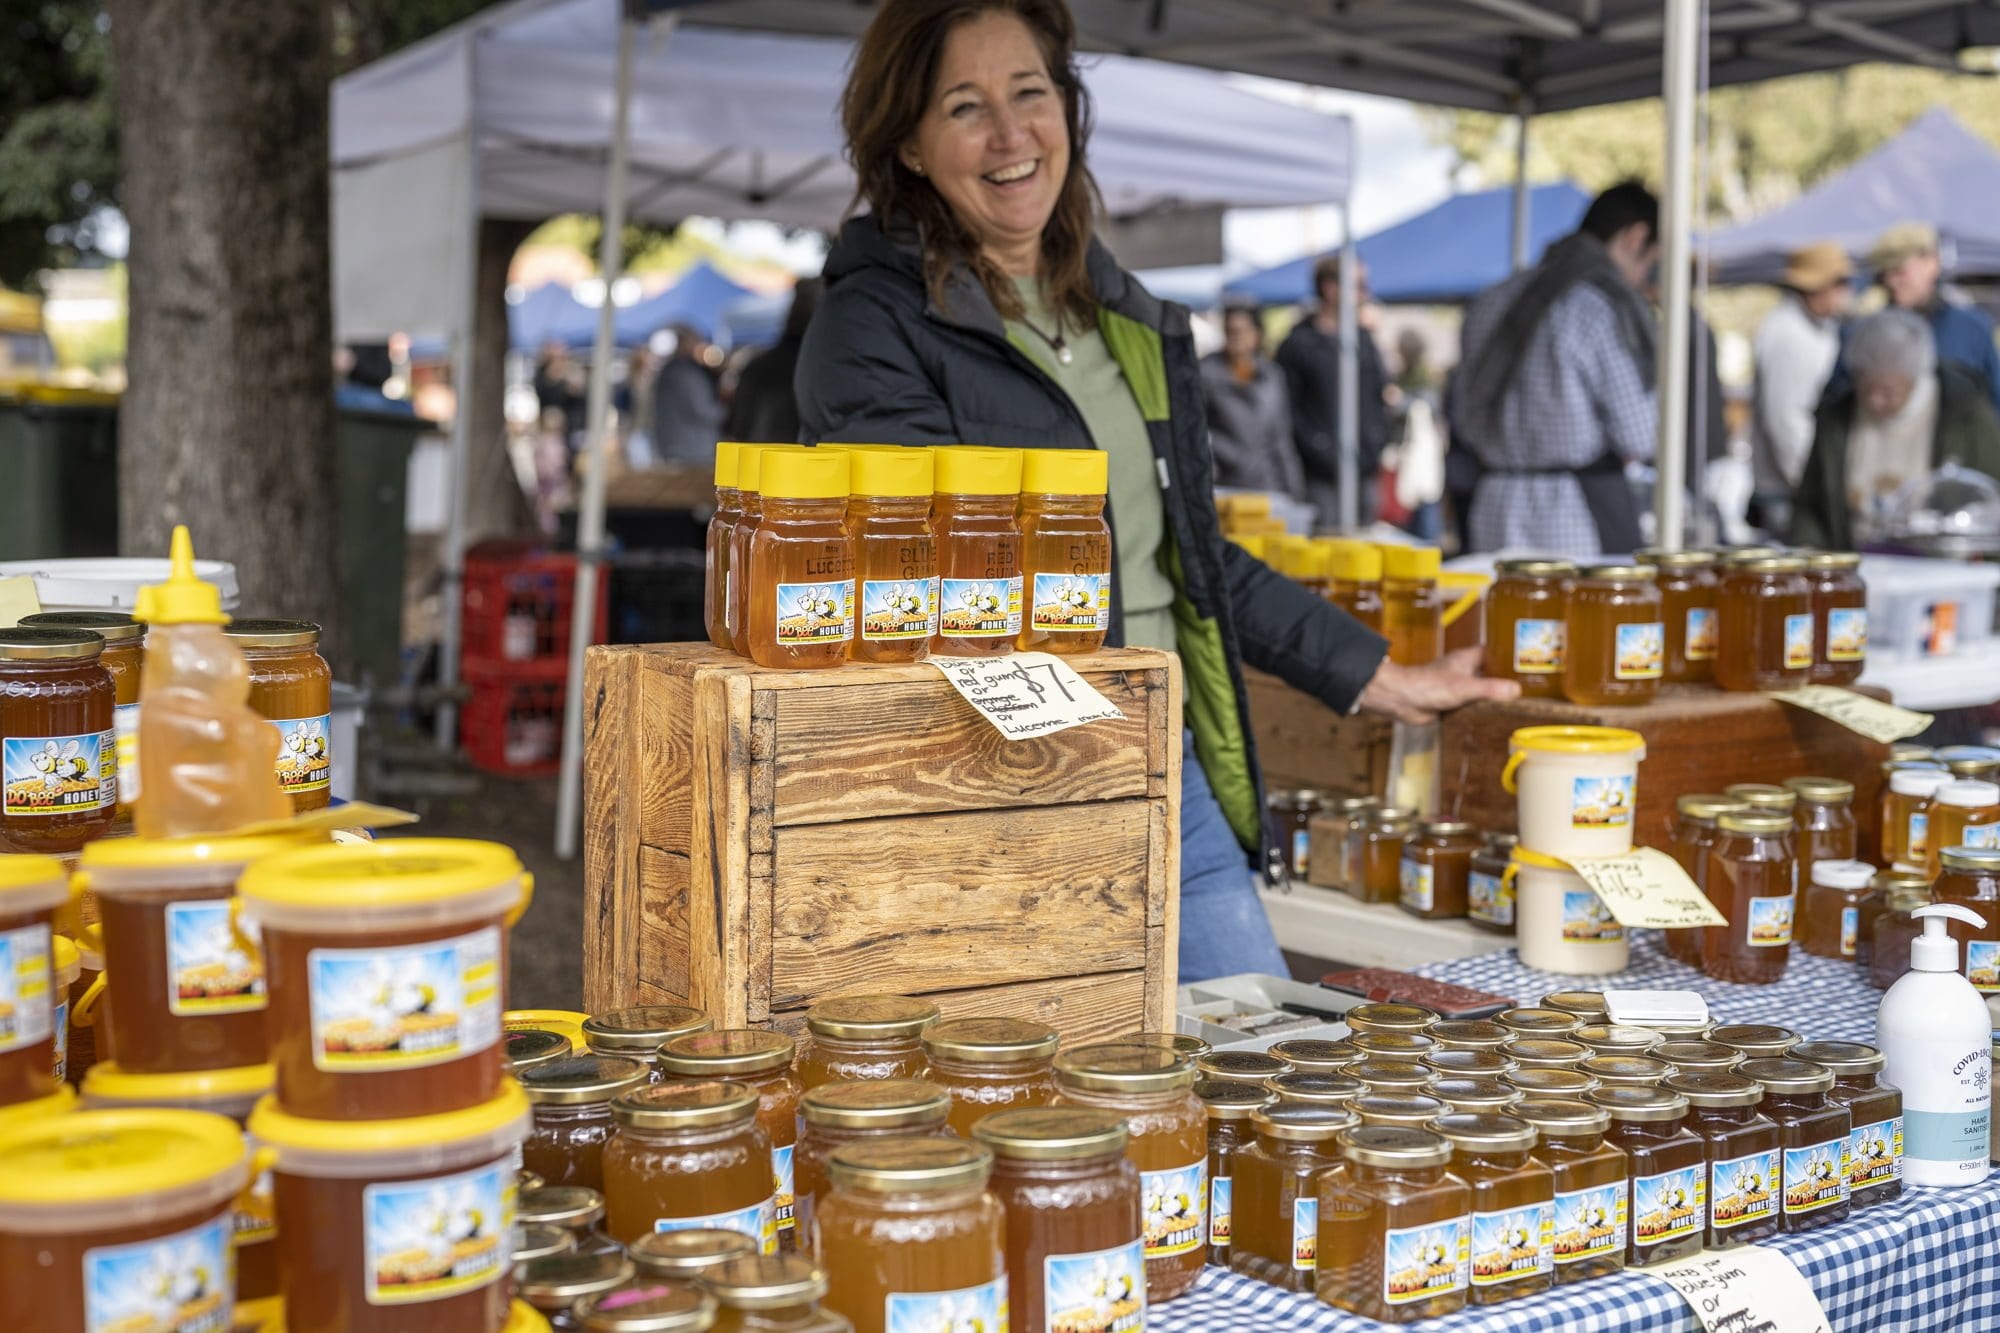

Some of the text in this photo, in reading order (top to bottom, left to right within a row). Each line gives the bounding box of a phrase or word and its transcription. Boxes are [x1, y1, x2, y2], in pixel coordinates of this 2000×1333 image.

[986, 551, 1014, 565] RED
[866, 619, 880, 631] DO
[903, 621, 928, 632] HONEY
[942, 617, 957, 629] DO
[981, 620, 1007, 630] HONEY
[1072, 615, 1097, 625] HONEY
[779, 623, 795, 636] DO
[819, 625, 844, 636] HONEY
[959, 667, 976, 676] or
[957, 672, 1015, 688] red gum
[971, 686, 989, 696] or
[1002, 717, 1069, 734] Lucerne
[7, 788, 27, 806] DO
[63, 788, 100, 805] HONEY
[1871, 1164, 1894, 1178] HONEY
[1818, 1185, 1841, 1200] HONEY
[1747, 1199, 1770, 1214] HONEY
[1166, 1226, 1199, 1246] HONEY
[1676, 1279, 1715, 1294] blue
[1711, 1268, 1747, 1289] gum
